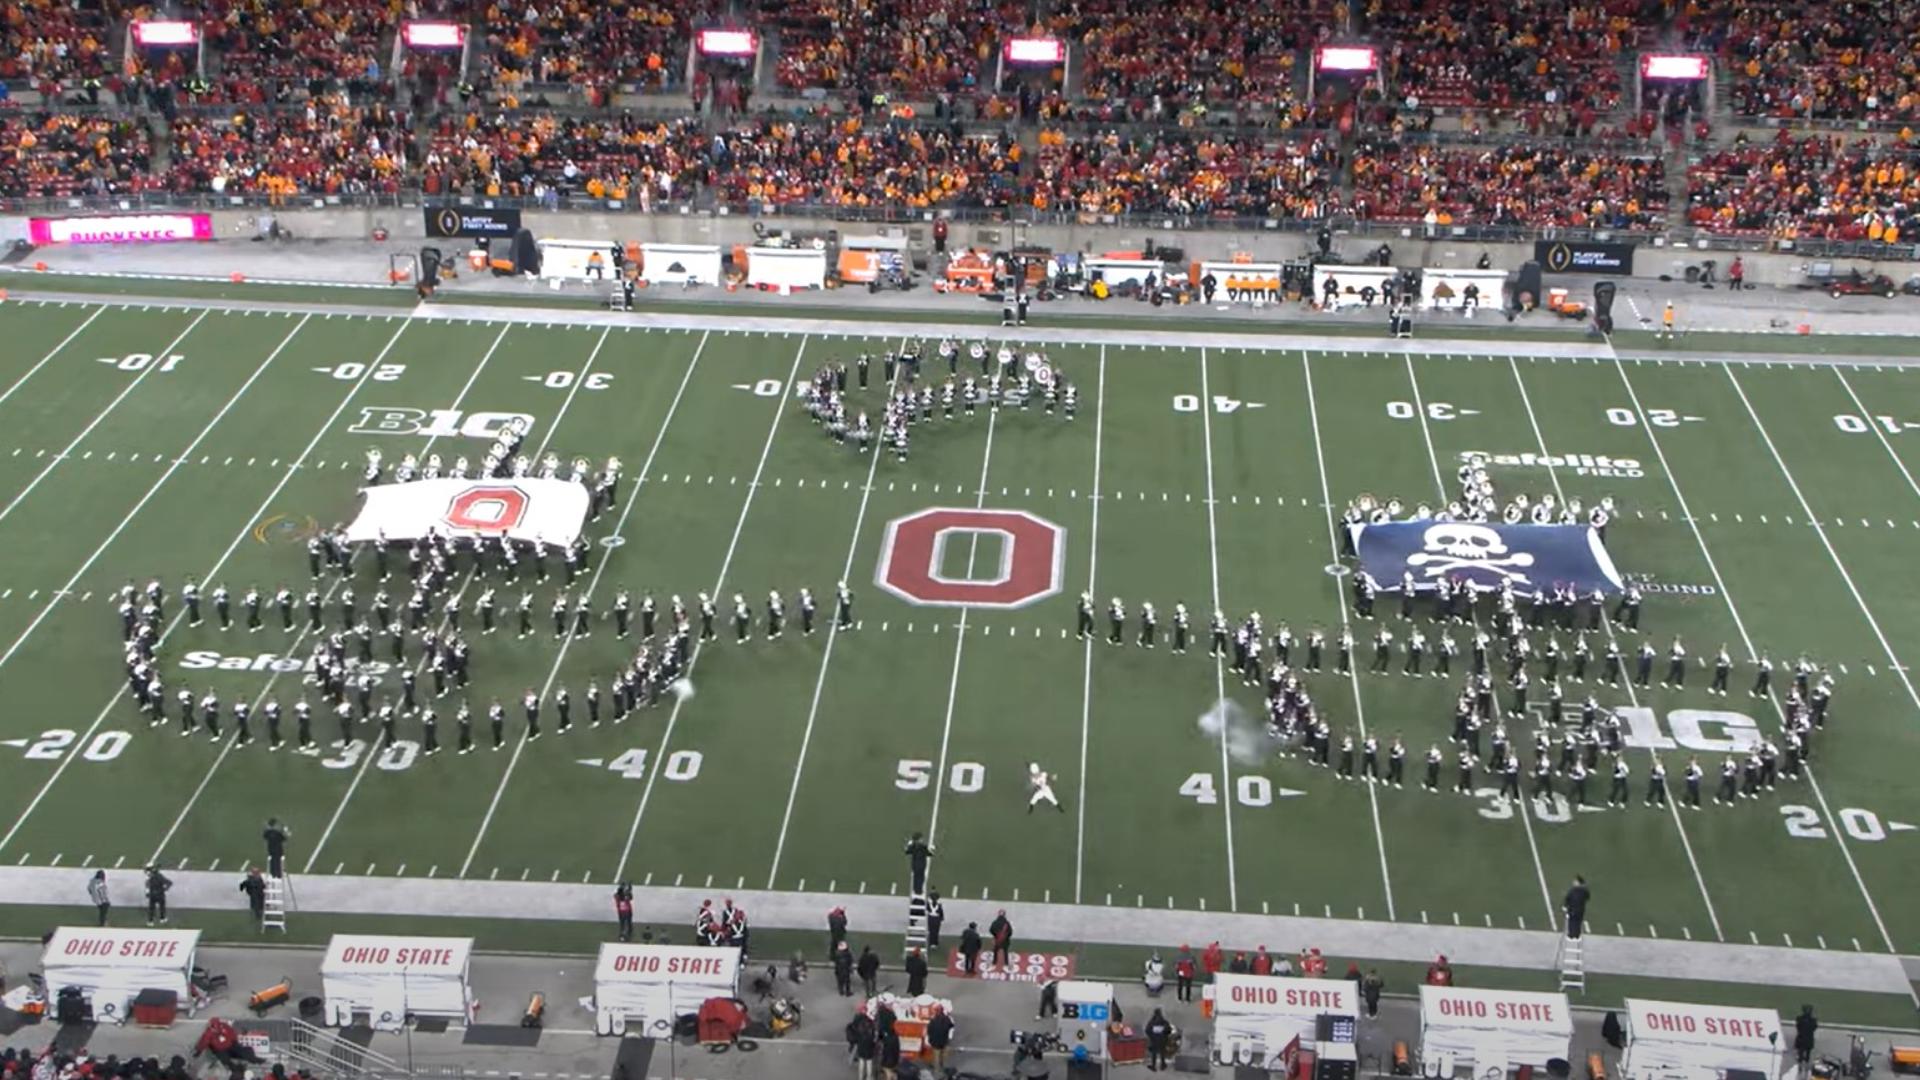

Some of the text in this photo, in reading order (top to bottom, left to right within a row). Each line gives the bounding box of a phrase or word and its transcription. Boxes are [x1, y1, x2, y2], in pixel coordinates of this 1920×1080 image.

[1576, 467, 1645, 478] FIELD
[873, 506, 1068, 609] O
[24, 729, 133, 761] 20
[321, 739, 420, 770] 30
[608, 748, 703, 781] 40
[895, 760, 985, 792] 50
[1179, 773, 1272, 806] 40
[1779, 804, 1886, 841] 20
[64, 938, 180, 958] OHIO STATE
[342, 947, 454, 966] OHIO STATE
[614, 955, 723, 975] OHIO STATE
[1231, 986, 1343, 1009] OHIO STATE
[1440, 998, 1554, 1022] OHIO STATE
[1646, 1013, 1767, 1039] OHIO STATE
